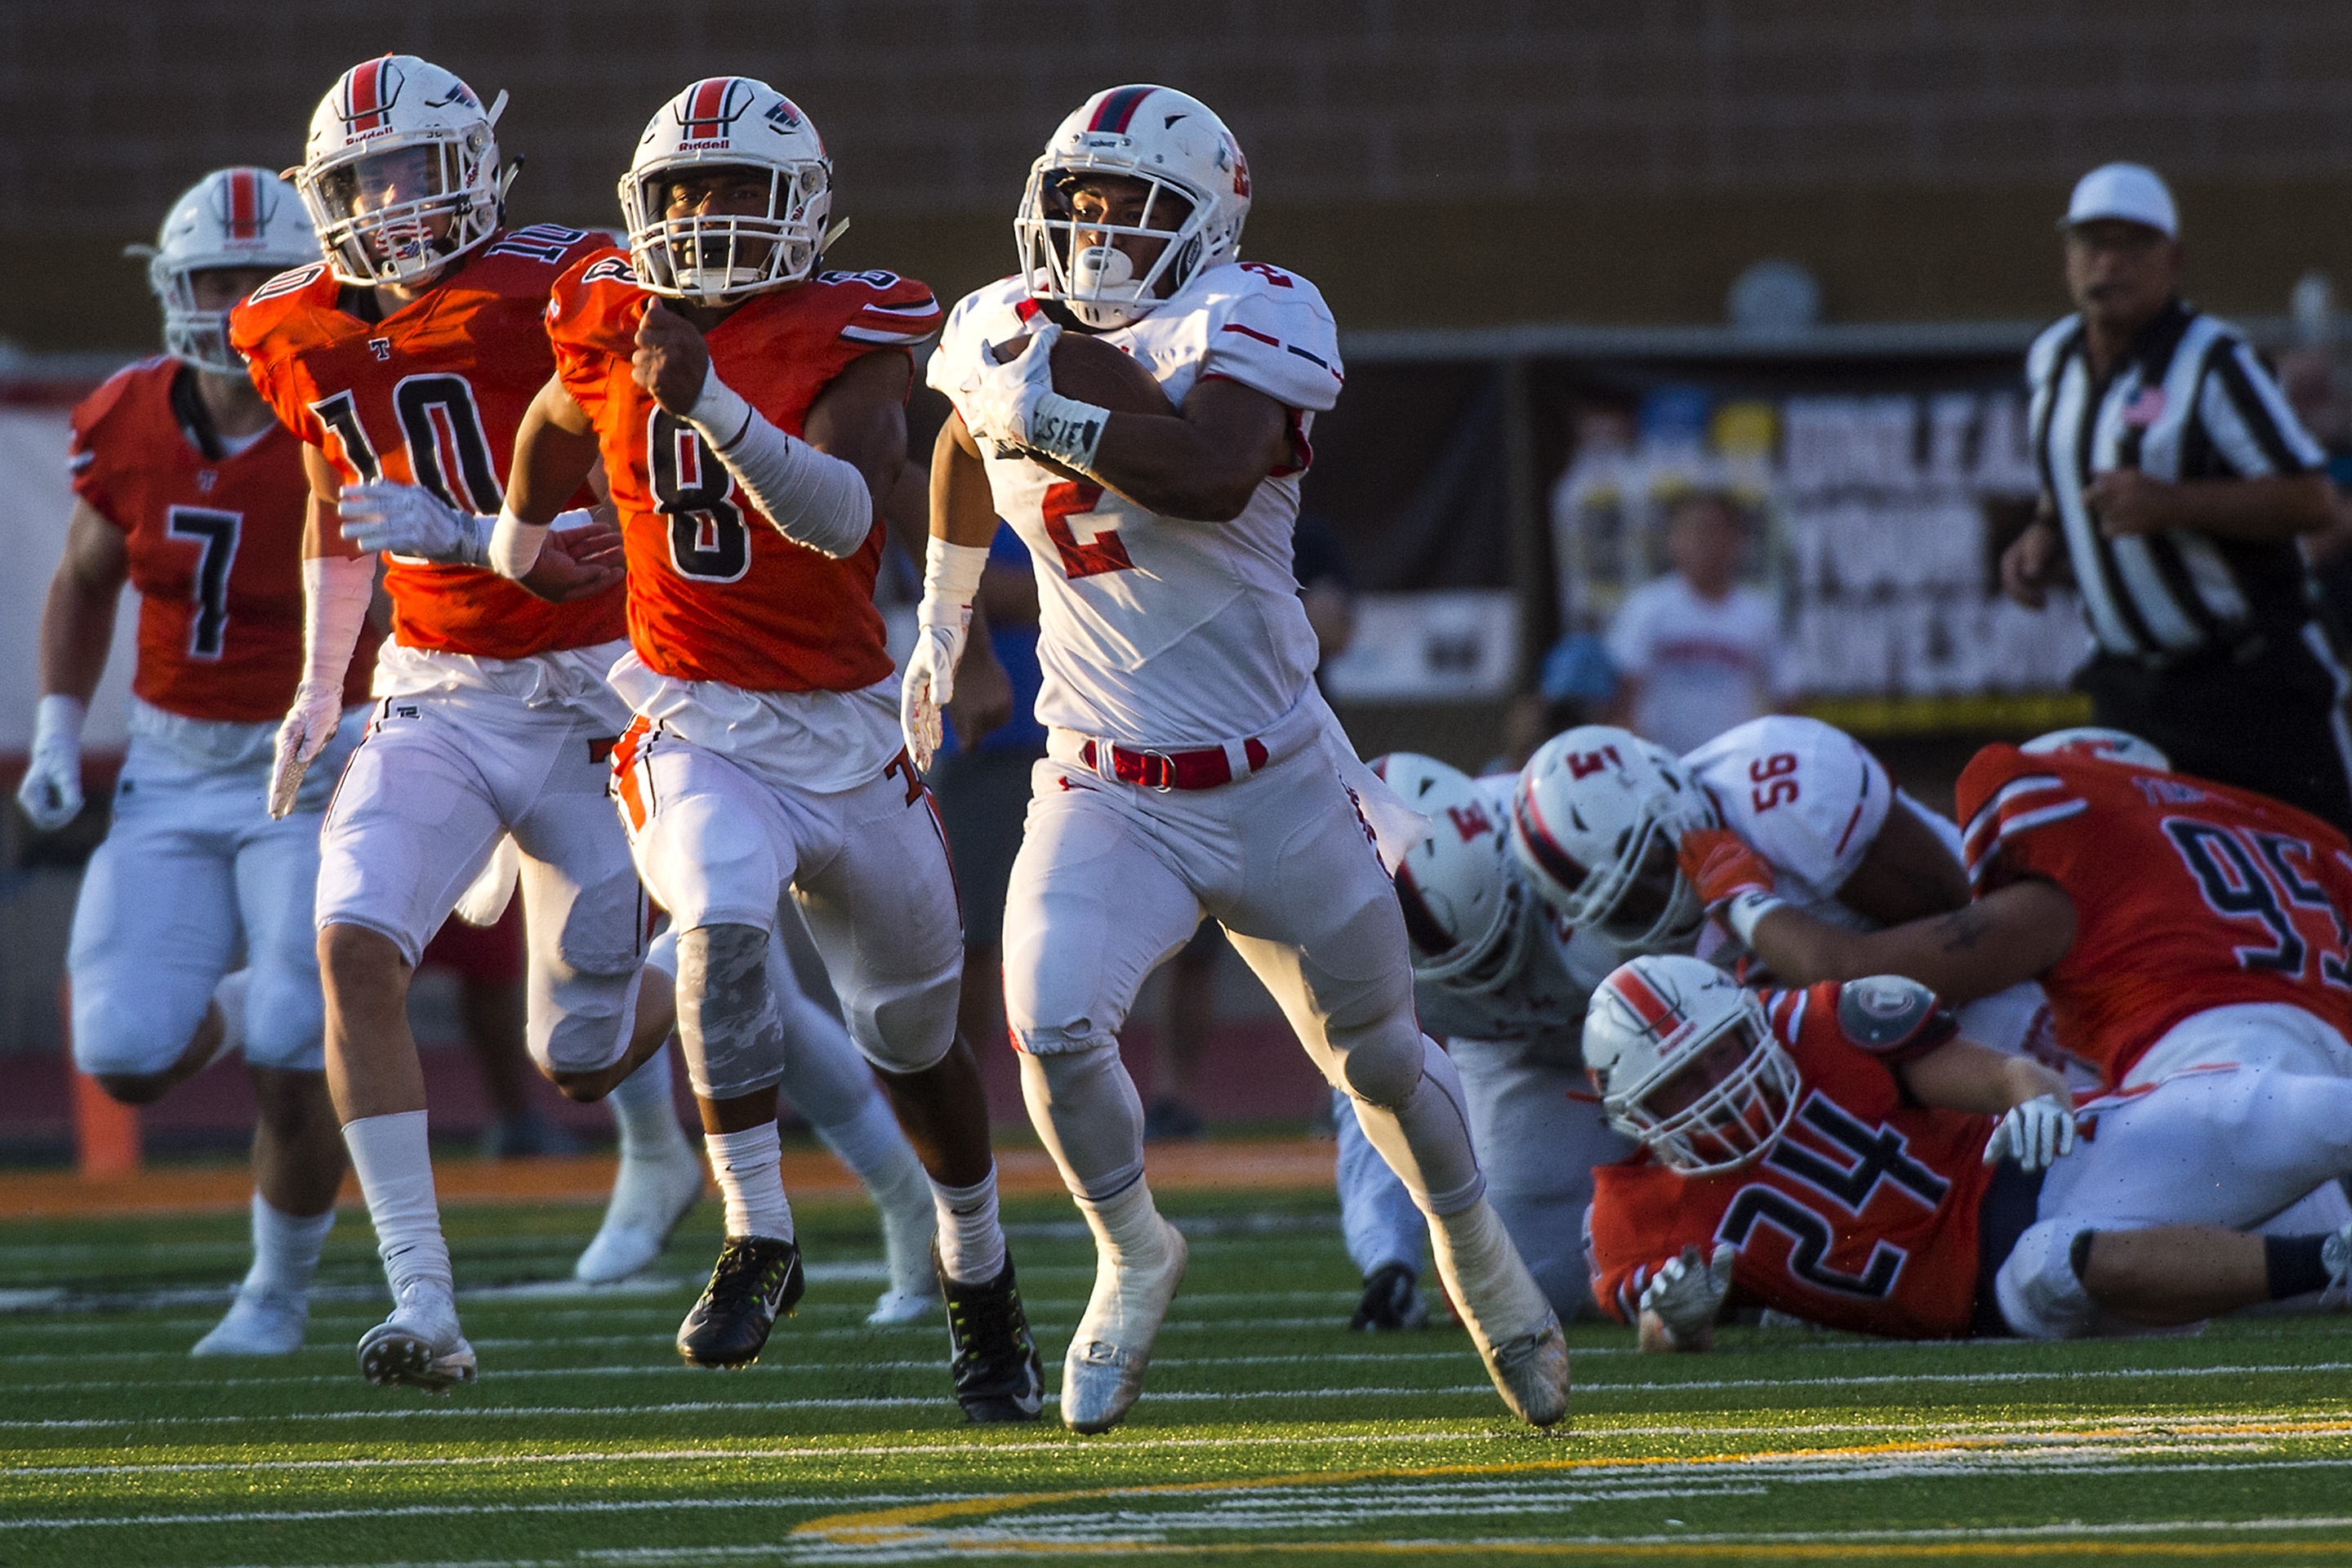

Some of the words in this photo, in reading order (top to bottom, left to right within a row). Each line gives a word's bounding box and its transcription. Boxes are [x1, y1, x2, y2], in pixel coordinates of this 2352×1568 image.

[679, 140, 730, 152] Riddell
[483, 223, 589, 265] 10
[1241, 261, 1294, 289] 2
[368, 337, 390, 362] T
[307, 372, 506, 546] 10
[648, 403, 751, 583] 8
[1041, 481, 1137, 579] 2
[167, 504, 244, 660] 7
[1749, 753, 1799, 814] 56
[2160, 815, 2352, 991] 95
[1713, 1089, 1952, 1300] 24
